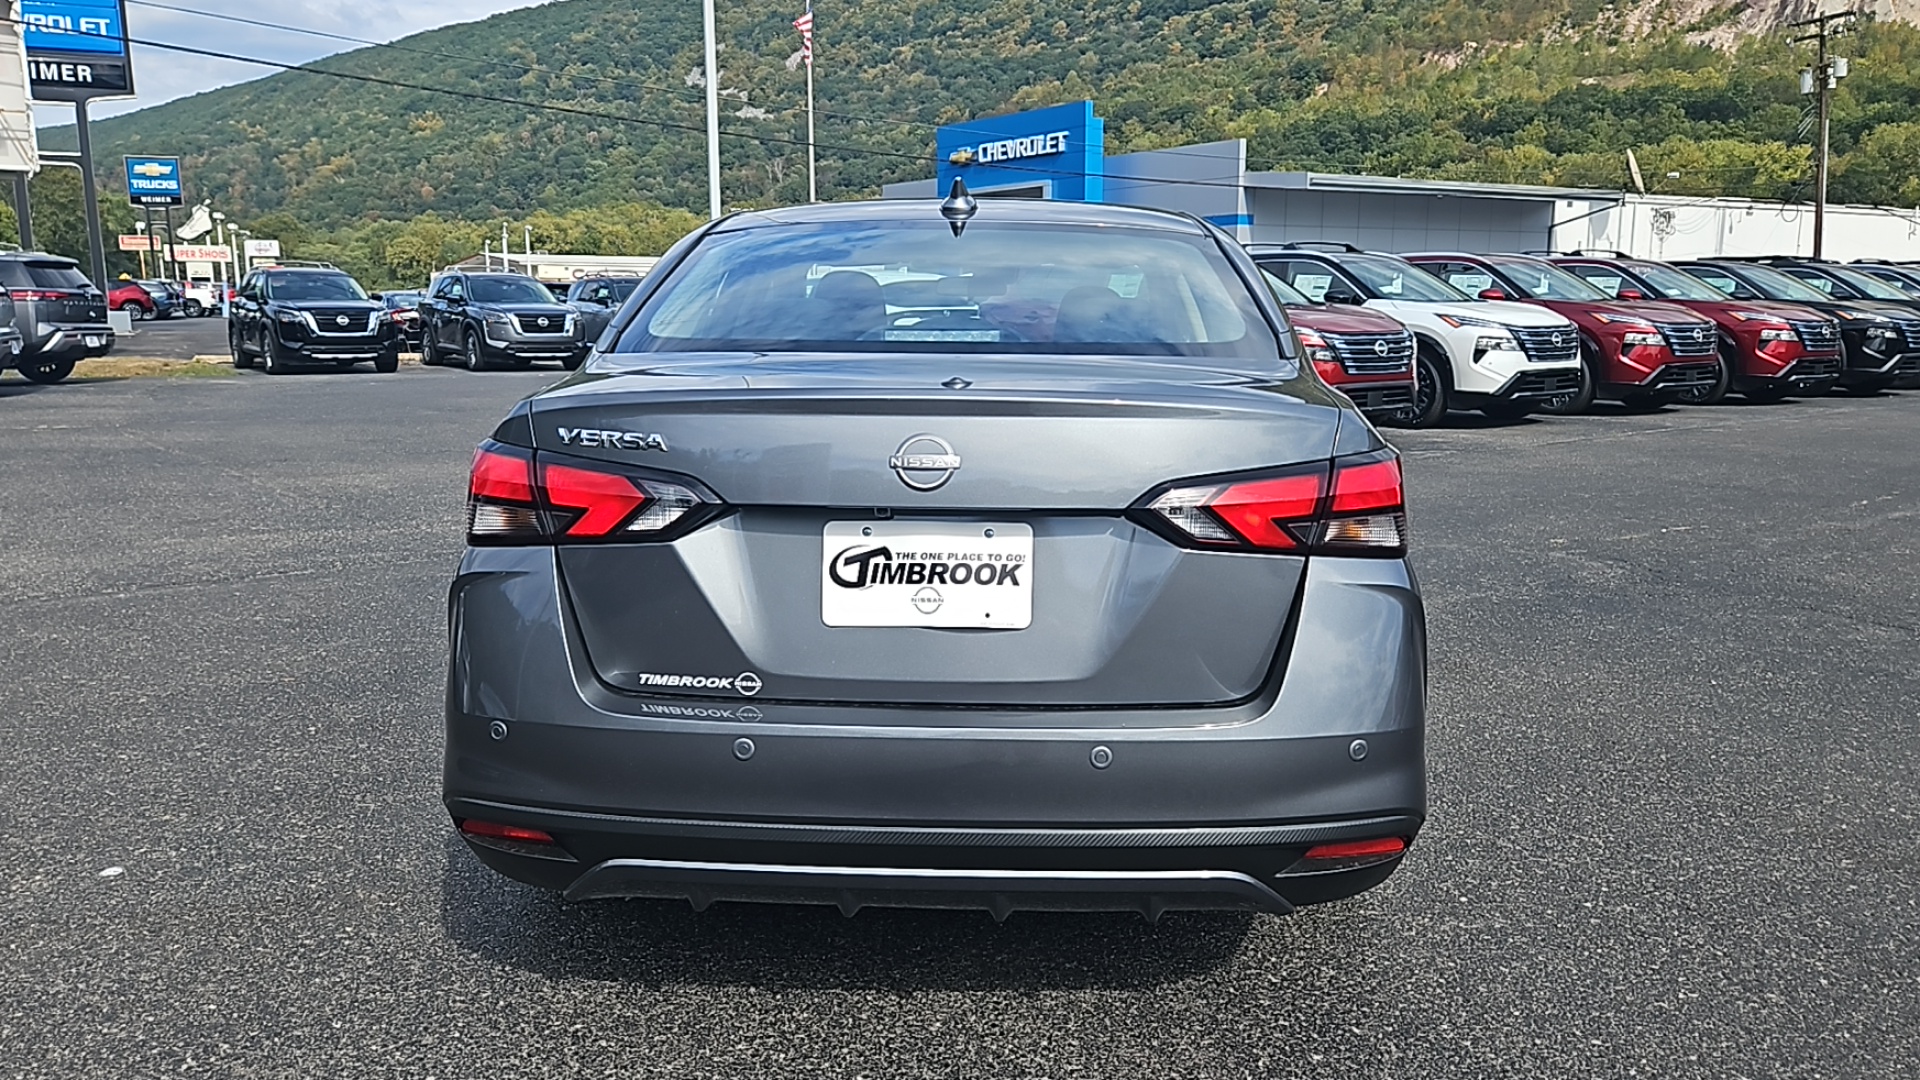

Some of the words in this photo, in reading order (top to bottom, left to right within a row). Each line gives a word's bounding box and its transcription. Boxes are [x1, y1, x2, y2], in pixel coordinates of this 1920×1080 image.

[978, 131, 1070, 163] CHEVROLET
[130, 179, 178, 189] TRUCKS
[169, 250, 196, 258] UPER
[558, 427, 668, 452] VERSA
[890, 456, 960, 468] NISSAN
[895, 552, 917, 560] THE
[920, 552, 943, 560] ONE
[947, 553, 983, 561] PLACE
[1006, 554, 1026, 562] GO!
[829, 545, 1023, 590] TIMBROOK
[639, 674, 734, 689] TIMBROOK
